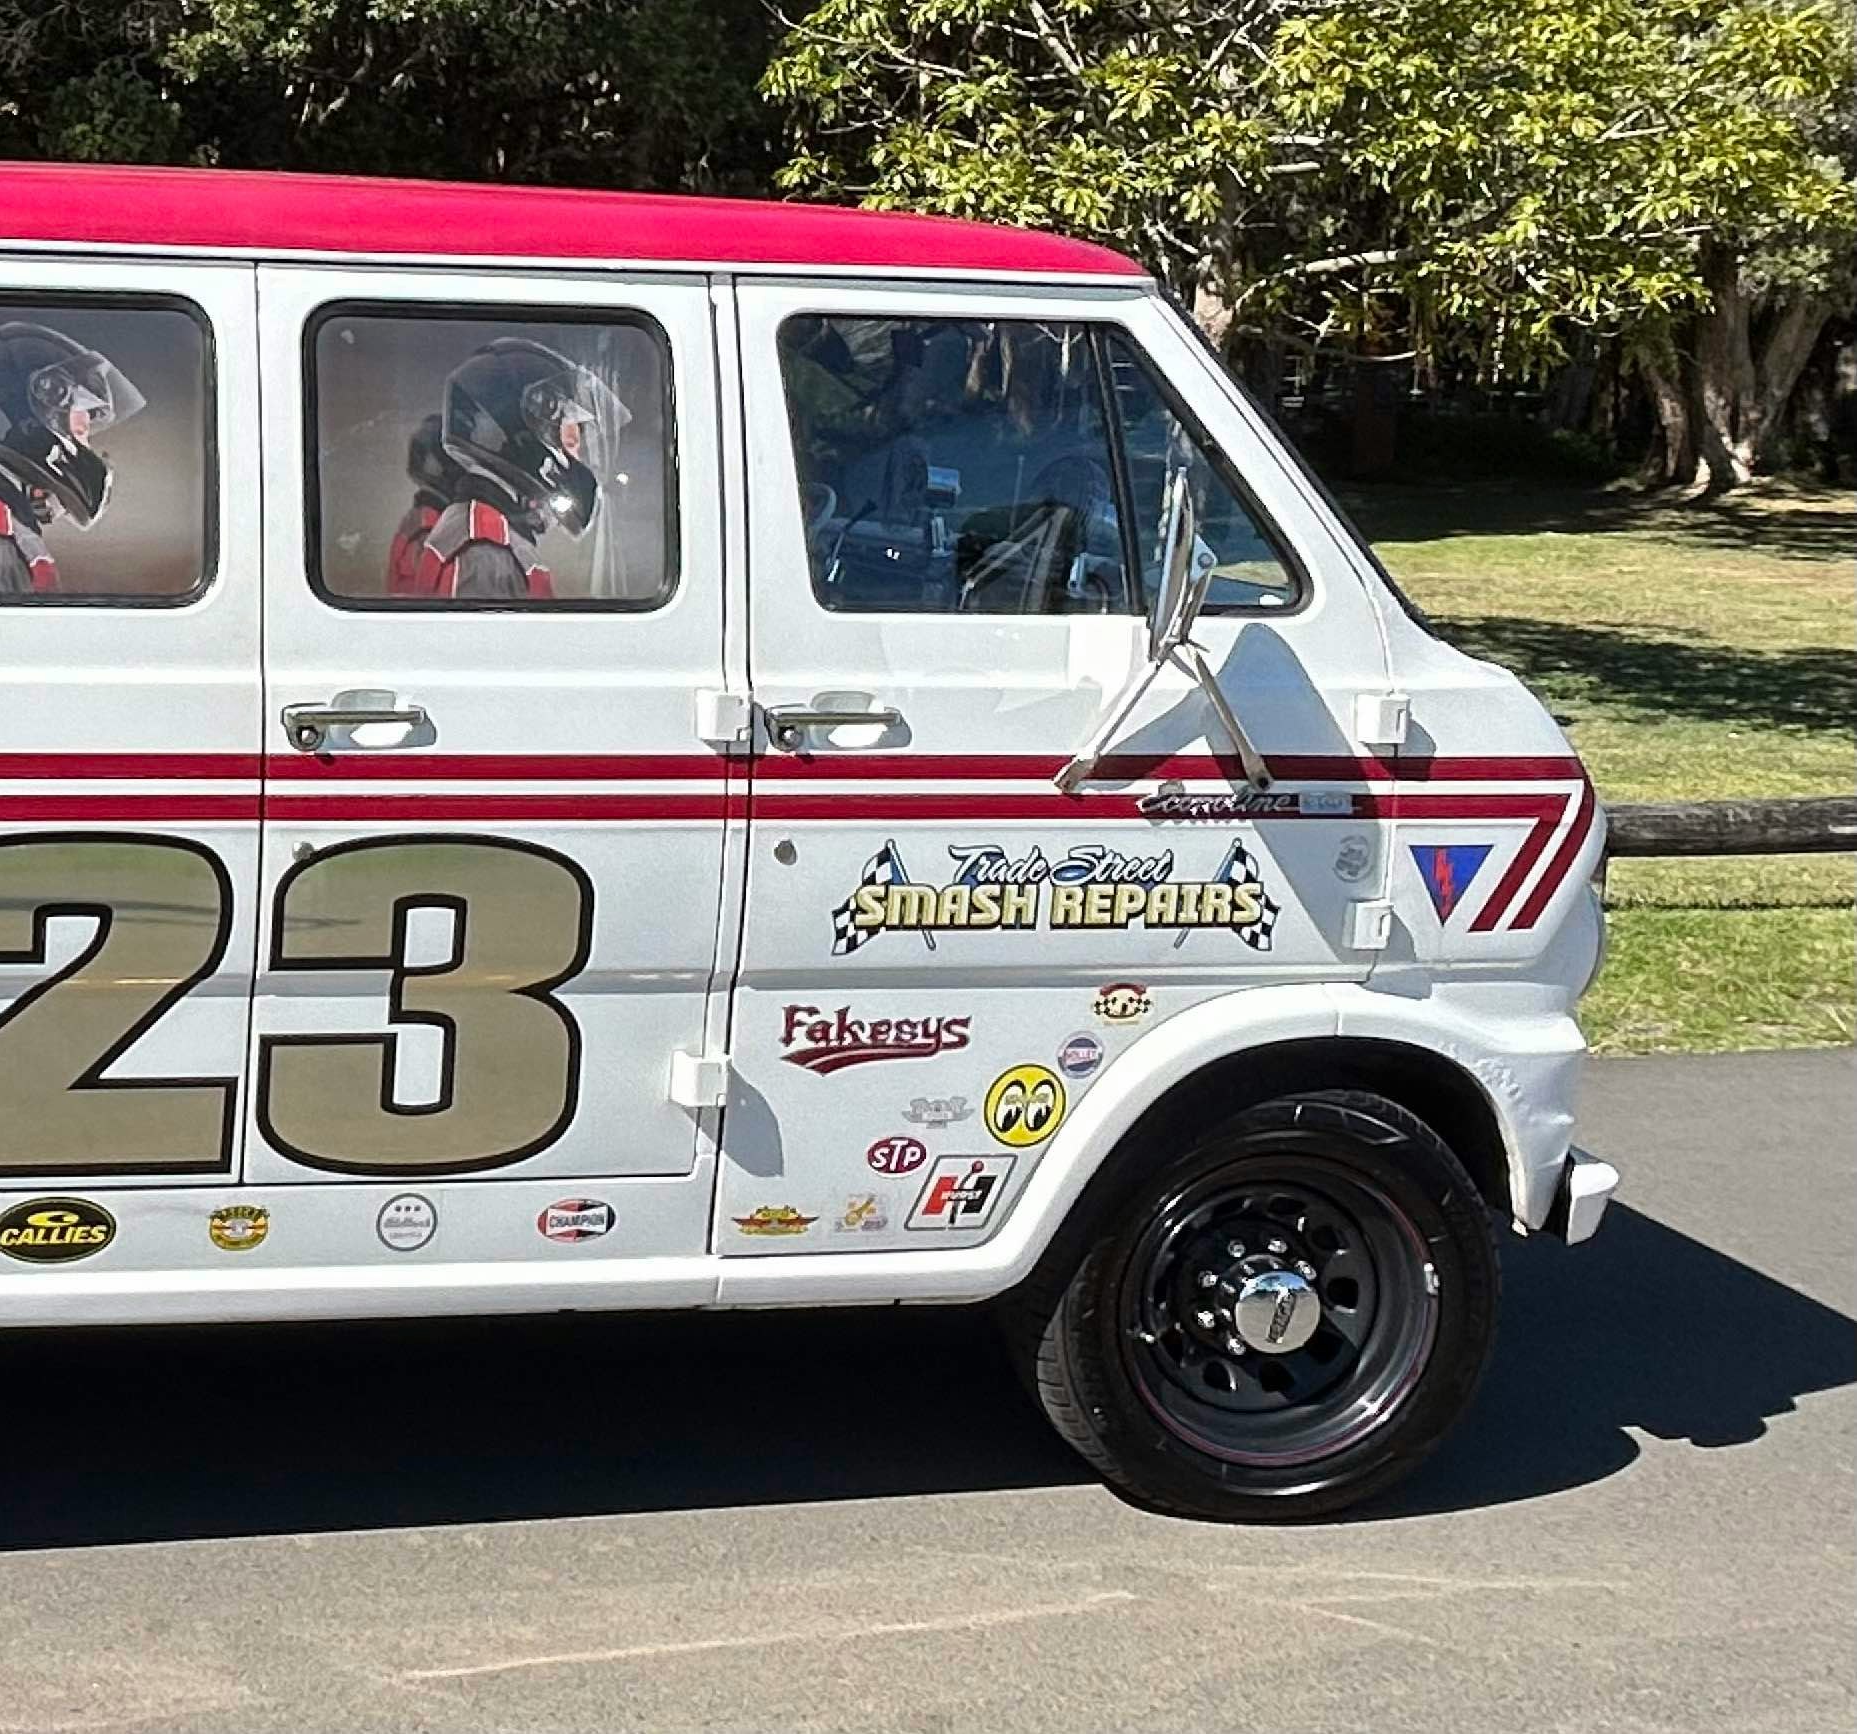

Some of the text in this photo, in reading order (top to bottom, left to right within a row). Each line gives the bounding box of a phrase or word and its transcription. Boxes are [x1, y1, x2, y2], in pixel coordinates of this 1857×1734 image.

[948, 842, 1175, 884] Trade Street
[850, 882, 1264, 932] SMASH REPAIRS
[871, 1140, 922, 1170] STP
[0, 1225, 109, 1246] CALLIES
